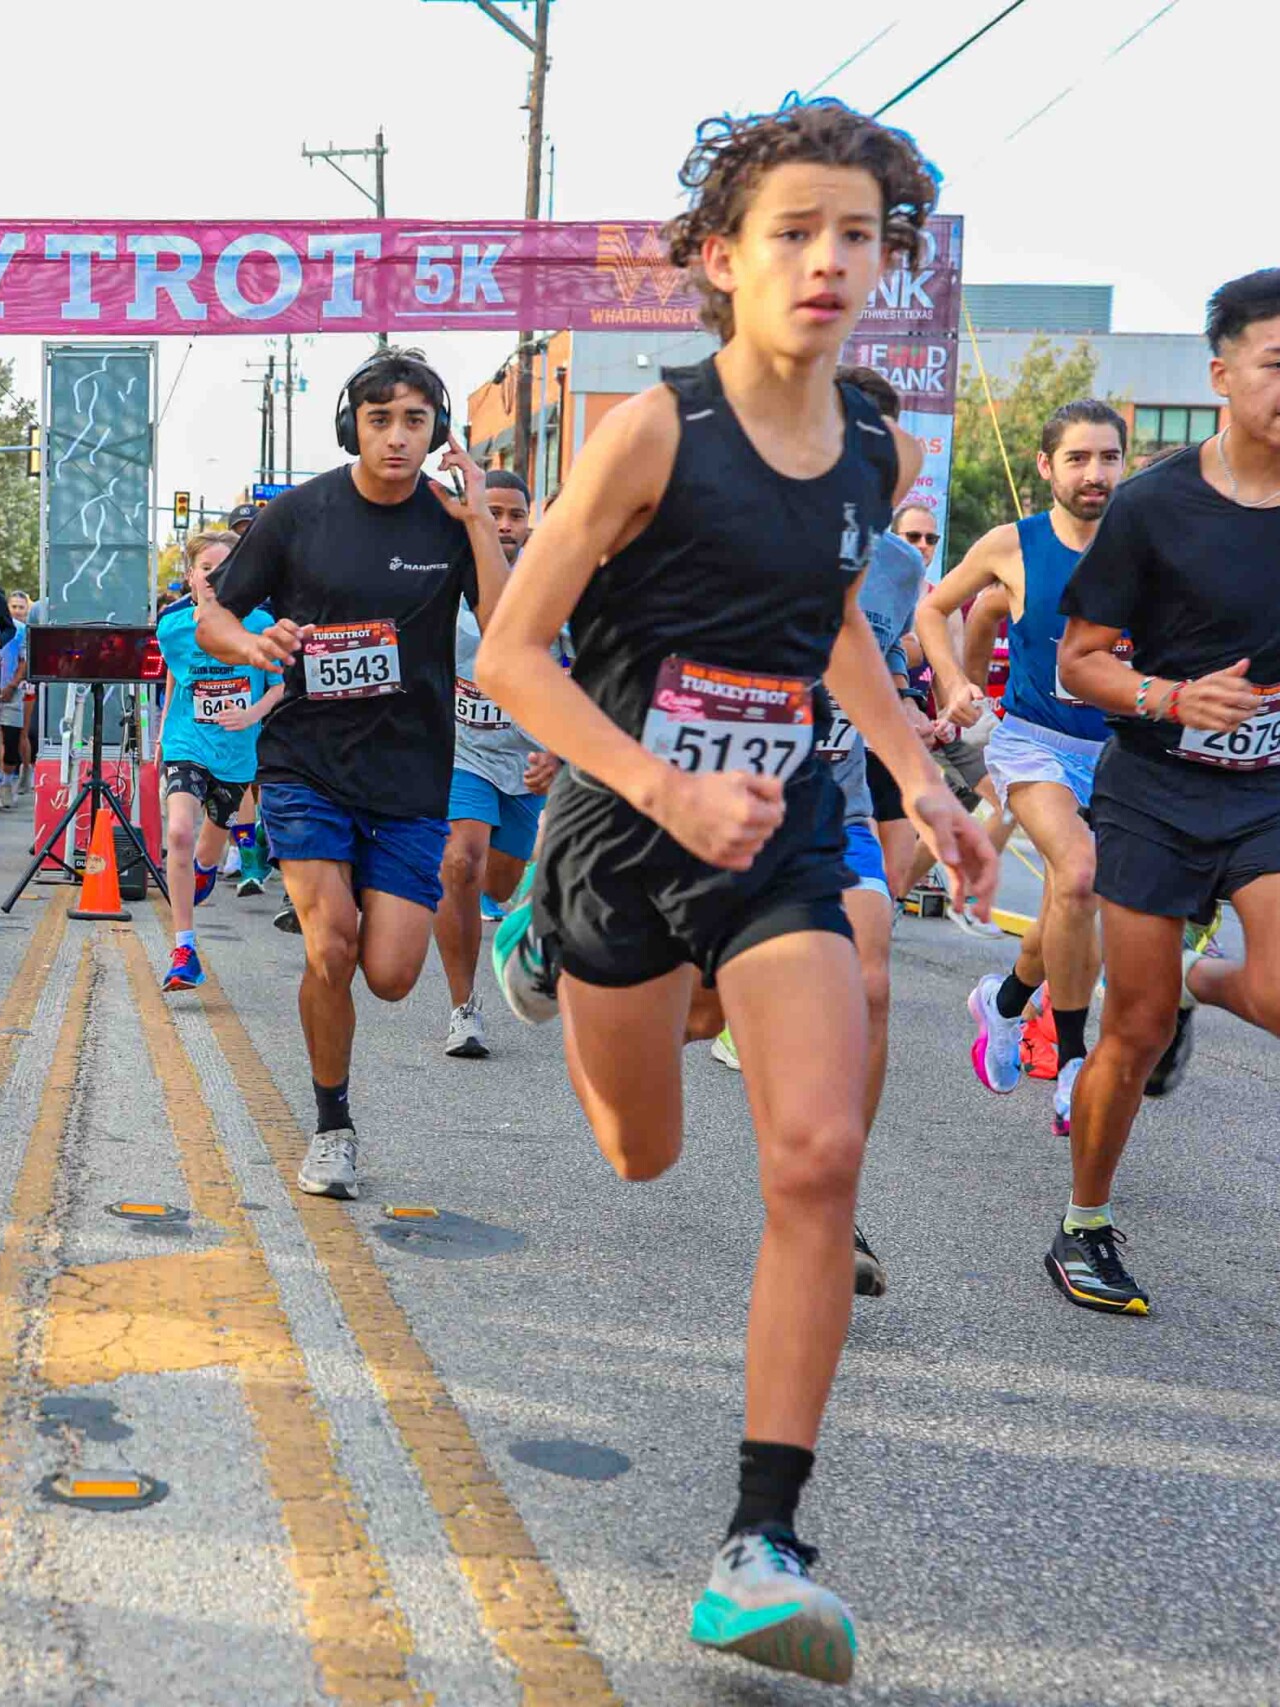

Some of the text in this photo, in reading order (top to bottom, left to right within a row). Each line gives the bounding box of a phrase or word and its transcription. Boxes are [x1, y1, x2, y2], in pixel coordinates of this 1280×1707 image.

[44, 233, 382, 321] TROT
[413, 243, 507, 305] 5K
[403, 563, 449, 571] MARINES
[320, 654, 390, 687] 5543
[670, 726, 797, 777] 5137
